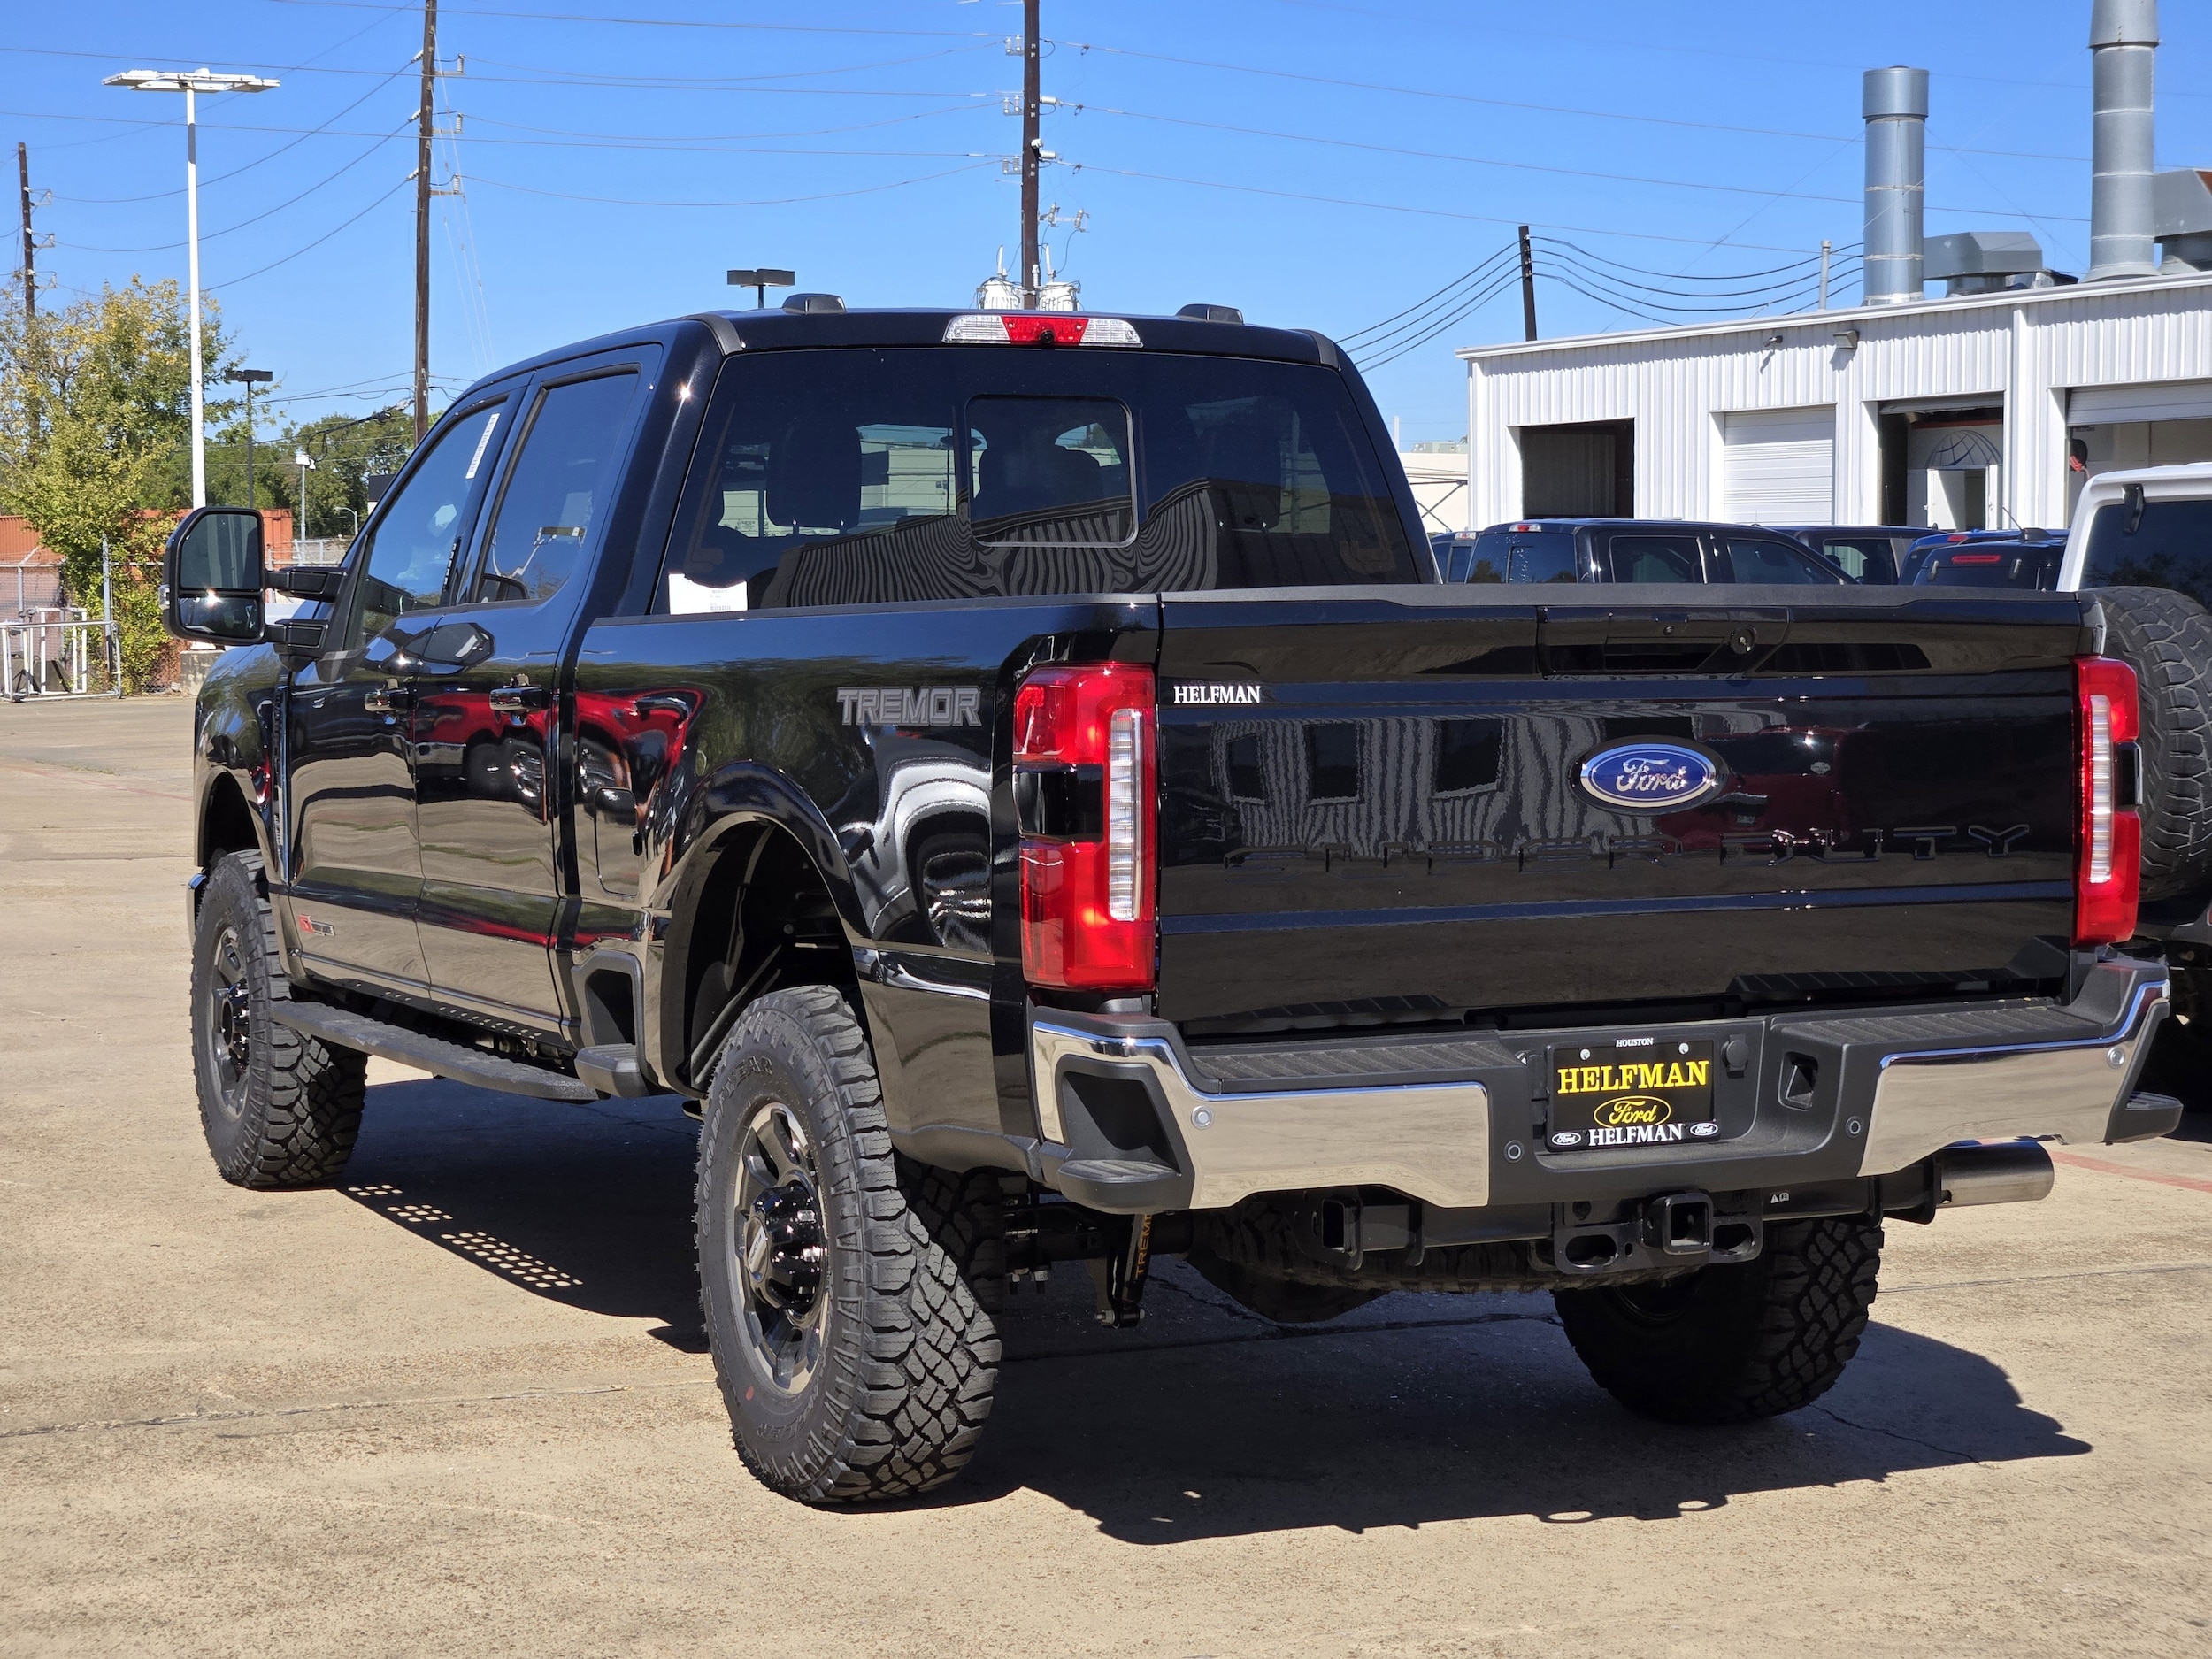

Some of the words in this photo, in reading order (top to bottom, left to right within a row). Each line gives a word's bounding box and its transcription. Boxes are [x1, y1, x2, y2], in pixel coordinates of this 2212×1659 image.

[1173, 685, 1261, 704] HELFMAN
[837, 686, 982, 727] TREMOR
[1616, 757, 1686, 793] Ford
[1616, 1037, 1654, 1048] HOUSTON
[1557, 1060, 1709, 1094] HELFMAN
[1609, 1101, 1658, 1124] Ford
[1588, 1123, 1685, 1146] HELFMAN
